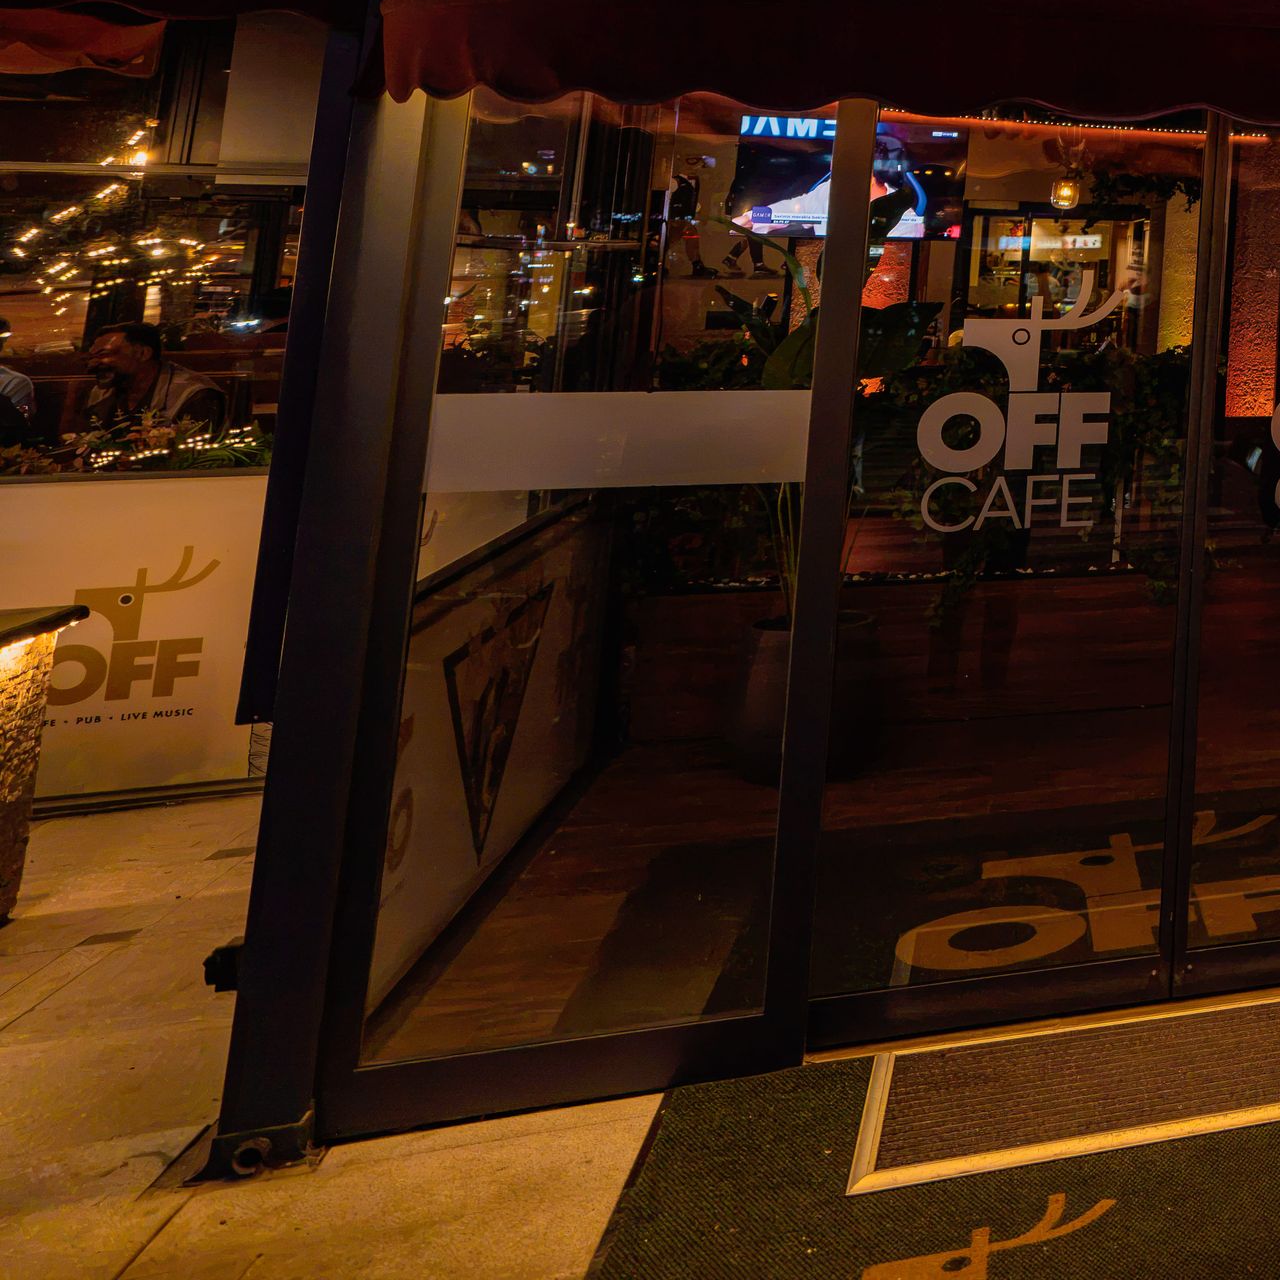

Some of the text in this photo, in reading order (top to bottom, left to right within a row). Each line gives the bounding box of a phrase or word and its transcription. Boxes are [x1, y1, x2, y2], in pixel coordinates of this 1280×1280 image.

[917, 392, 1111, 472] OFF
[921, 473, 1096, 532] CAFE
[44, 637, 203, 706] OFF
[76, 715, 101, 725] PUB
[121, 712, 147, 721] LIVE
[153, 708, 194, 718] MUSIC
